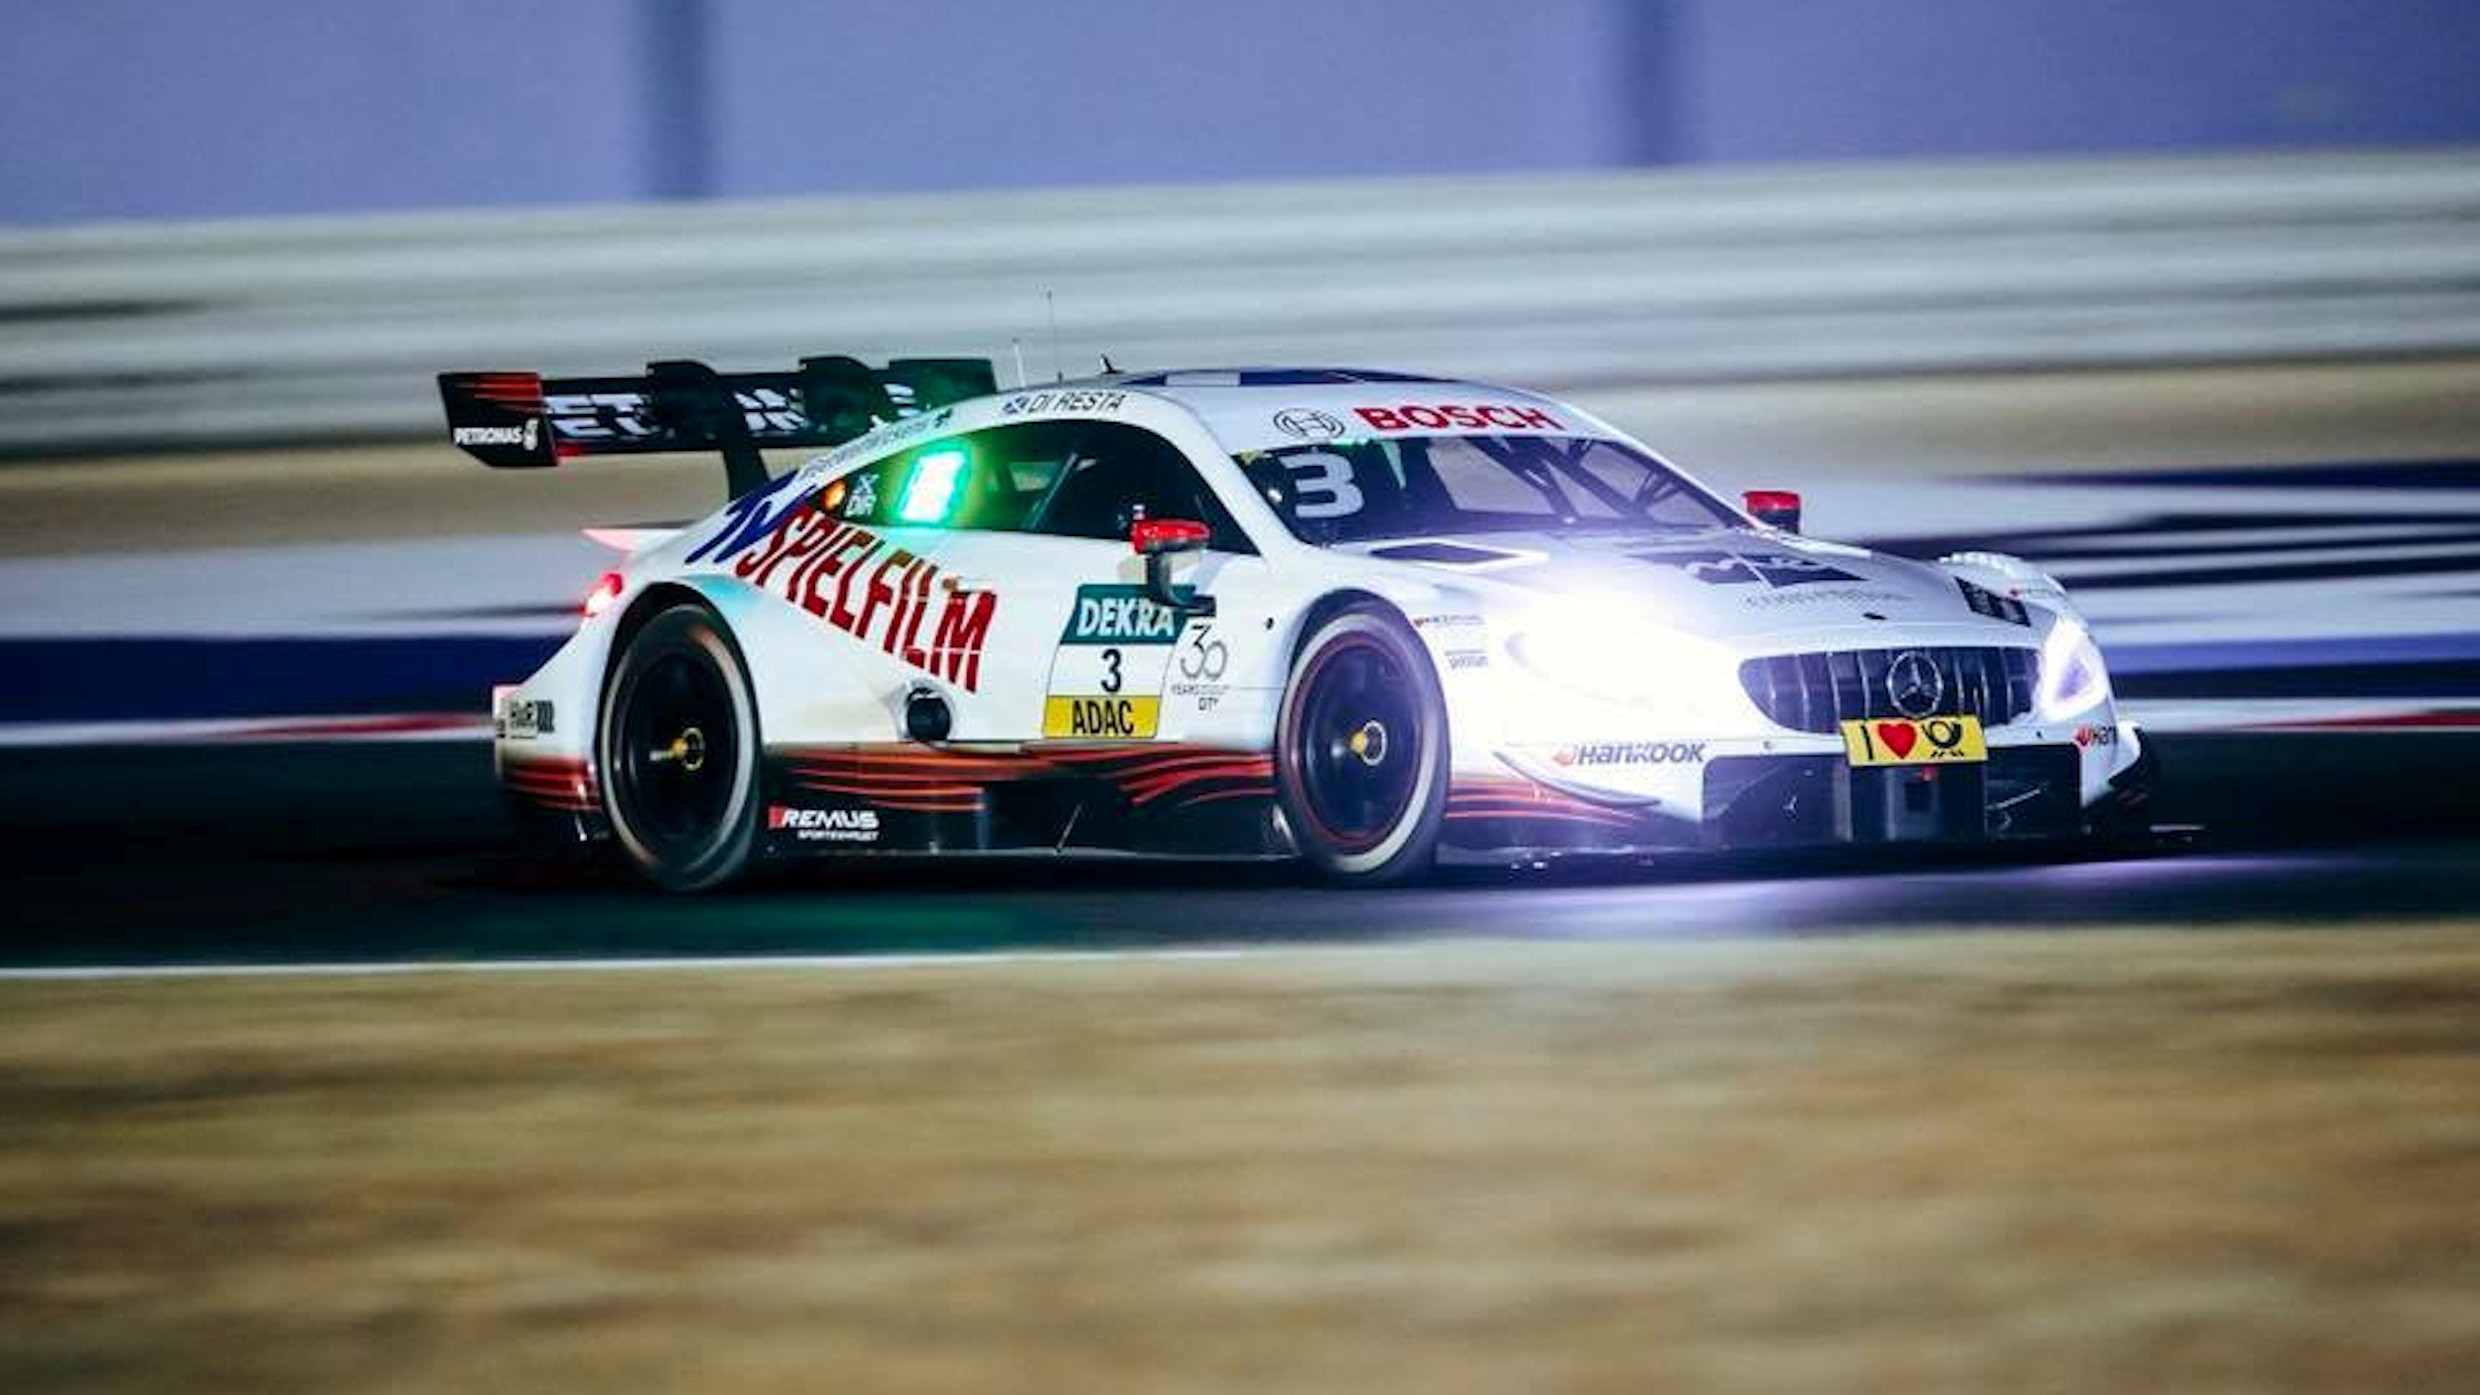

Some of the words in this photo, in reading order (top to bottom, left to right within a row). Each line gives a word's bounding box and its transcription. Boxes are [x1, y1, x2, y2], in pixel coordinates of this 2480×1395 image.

[1054, 392, 1126, 411] RESTA
[1353, 405, 1566, 431] BOSCH
[453, 426, 523, 445] PETRONAS
[1278, 453, 1364, 519] 3
[734, 501, 998, 693] SPIELFILM
[1076, 597, 1175, 637] DEKRA
[1101, 648, 1122, 693] 3
[1180, 624, 1228, 681] 30
[1072, 700, 1134, 735] ADAC
[1861, 724, 1874, 760] I
[782, 809, 879, 829] REMUS
